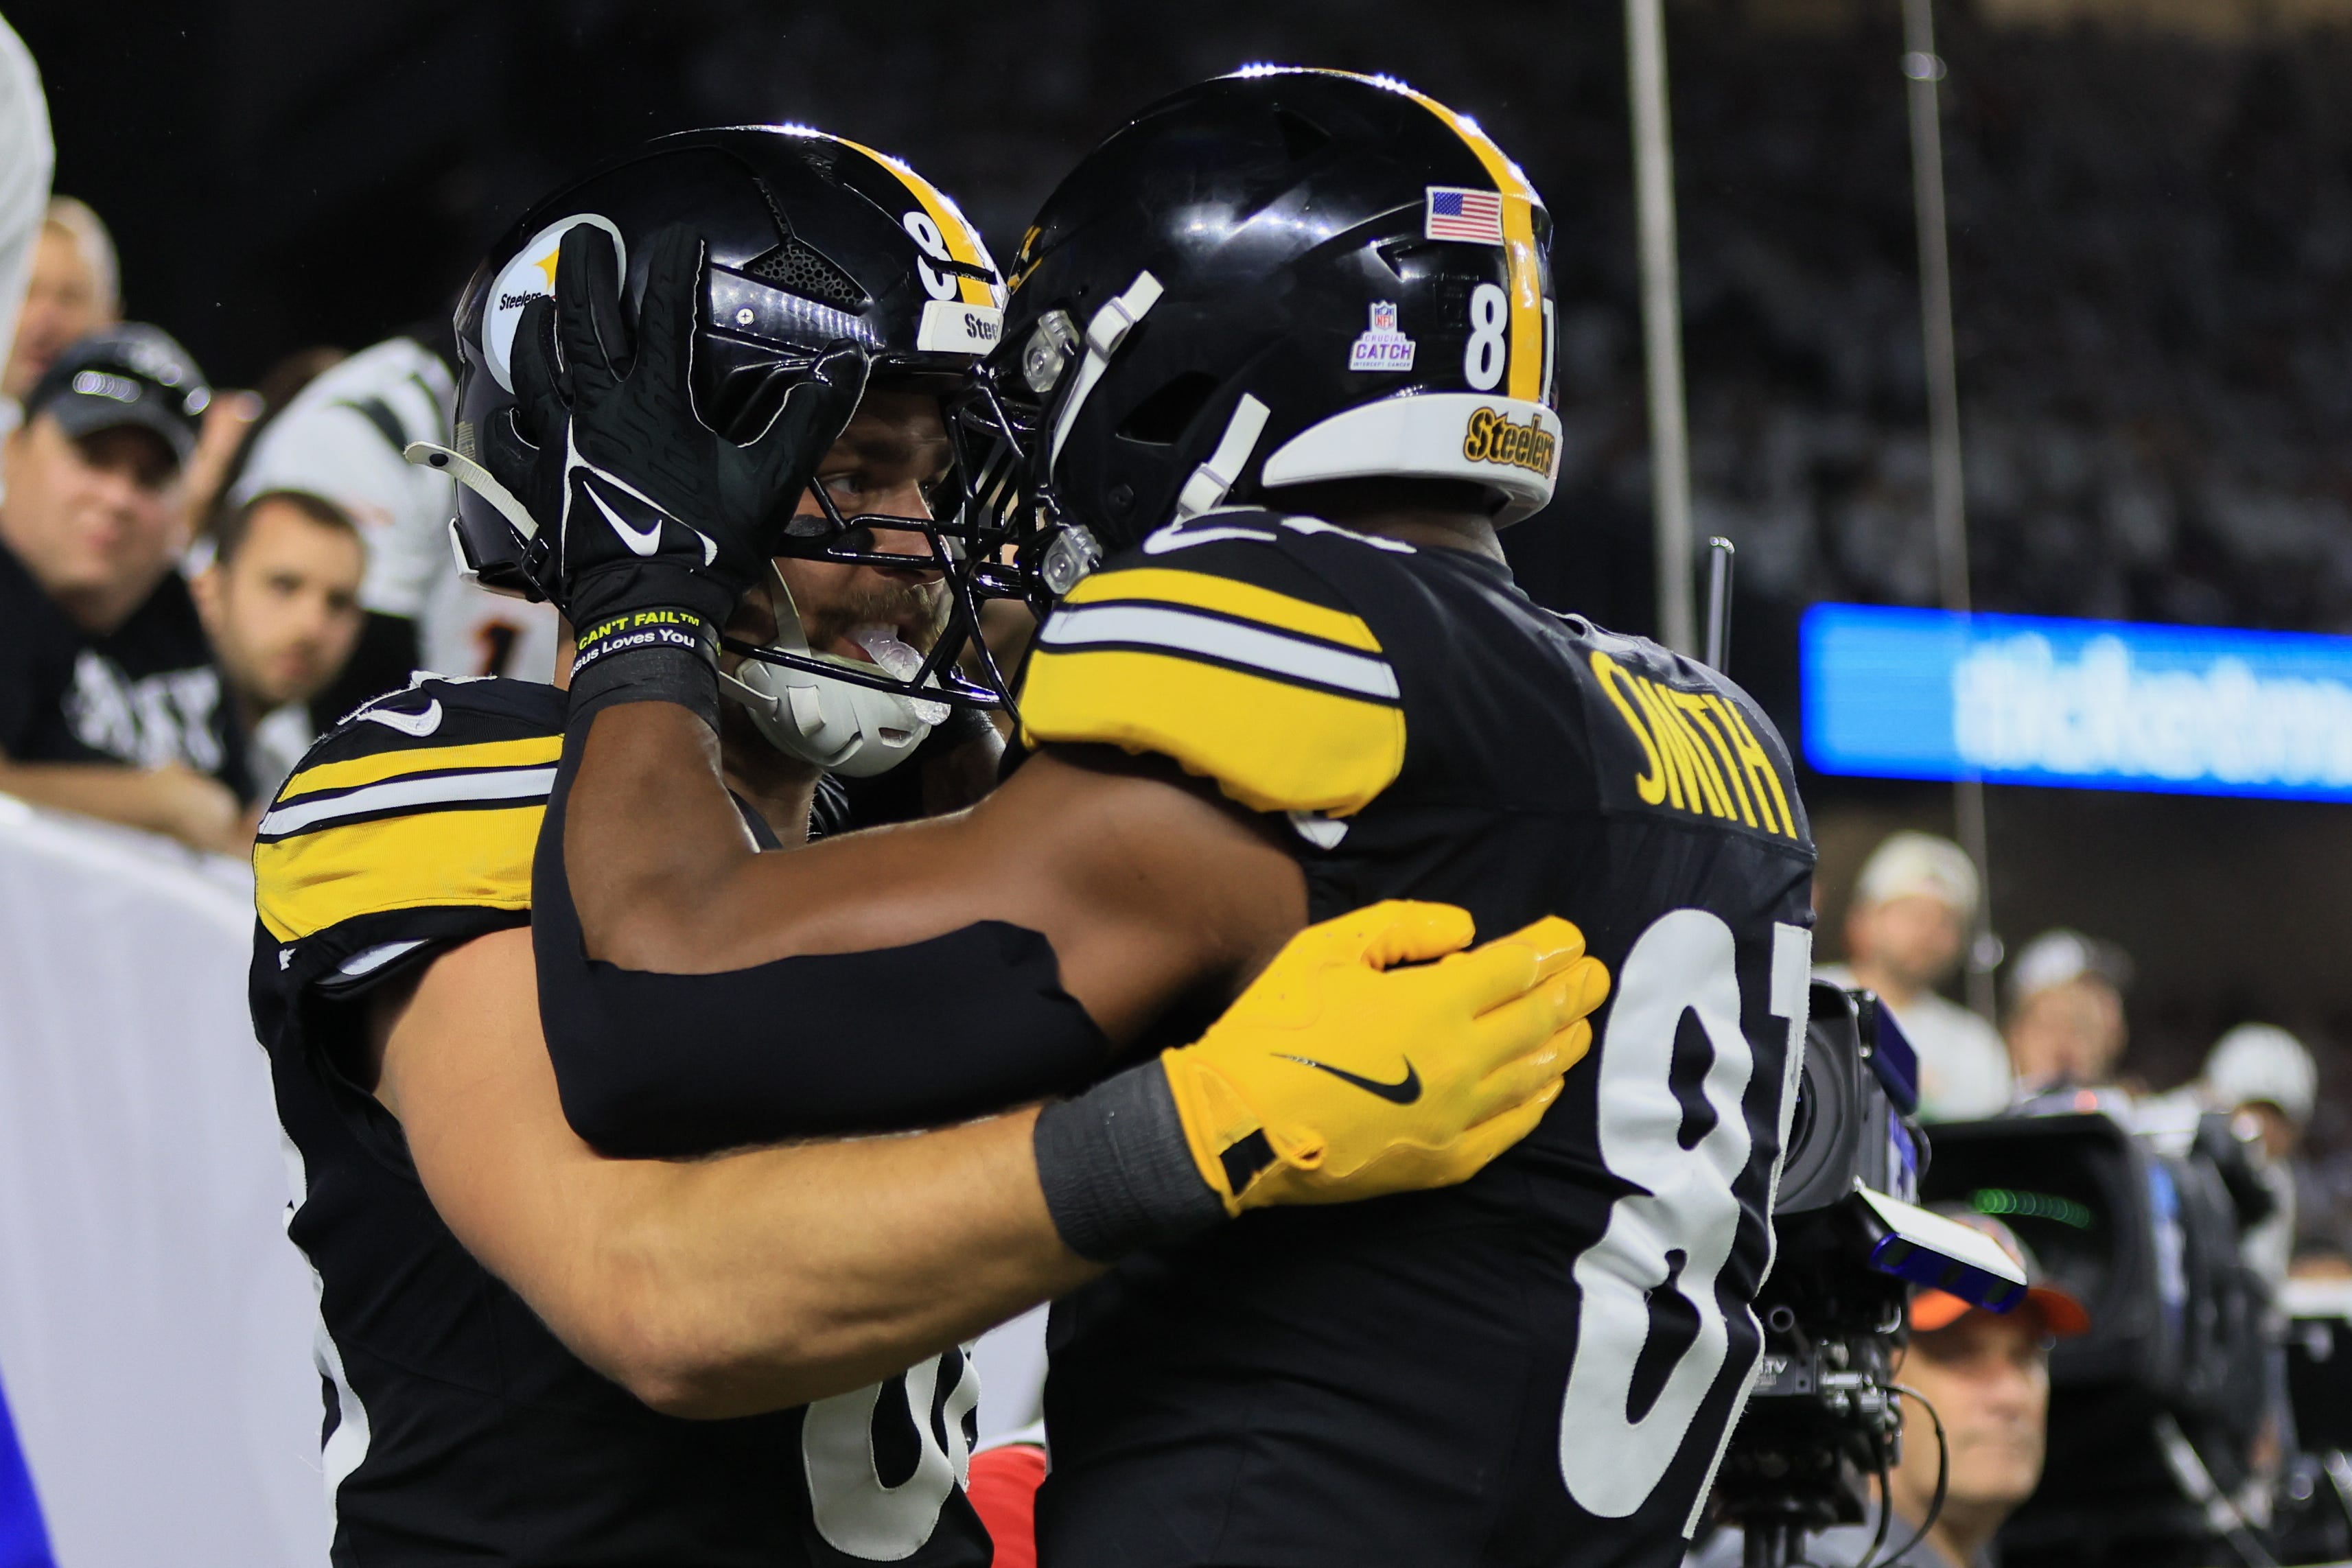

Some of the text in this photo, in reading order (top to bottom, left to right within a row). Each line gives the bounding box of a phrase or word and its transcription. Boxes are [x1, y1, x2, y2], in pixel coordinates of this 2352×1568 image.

[1375, 316, 1394, 327] NFL
[1356, 344, 1412, 360] CATCH
[1463, 406, 1555, 479] Steelers
[578, 618, 629, 651] CAN'T
[601, 631, 655, 654] Loves
[659, 629, 695, 648] You
[1589, 651, 1799, 841] SMITH
